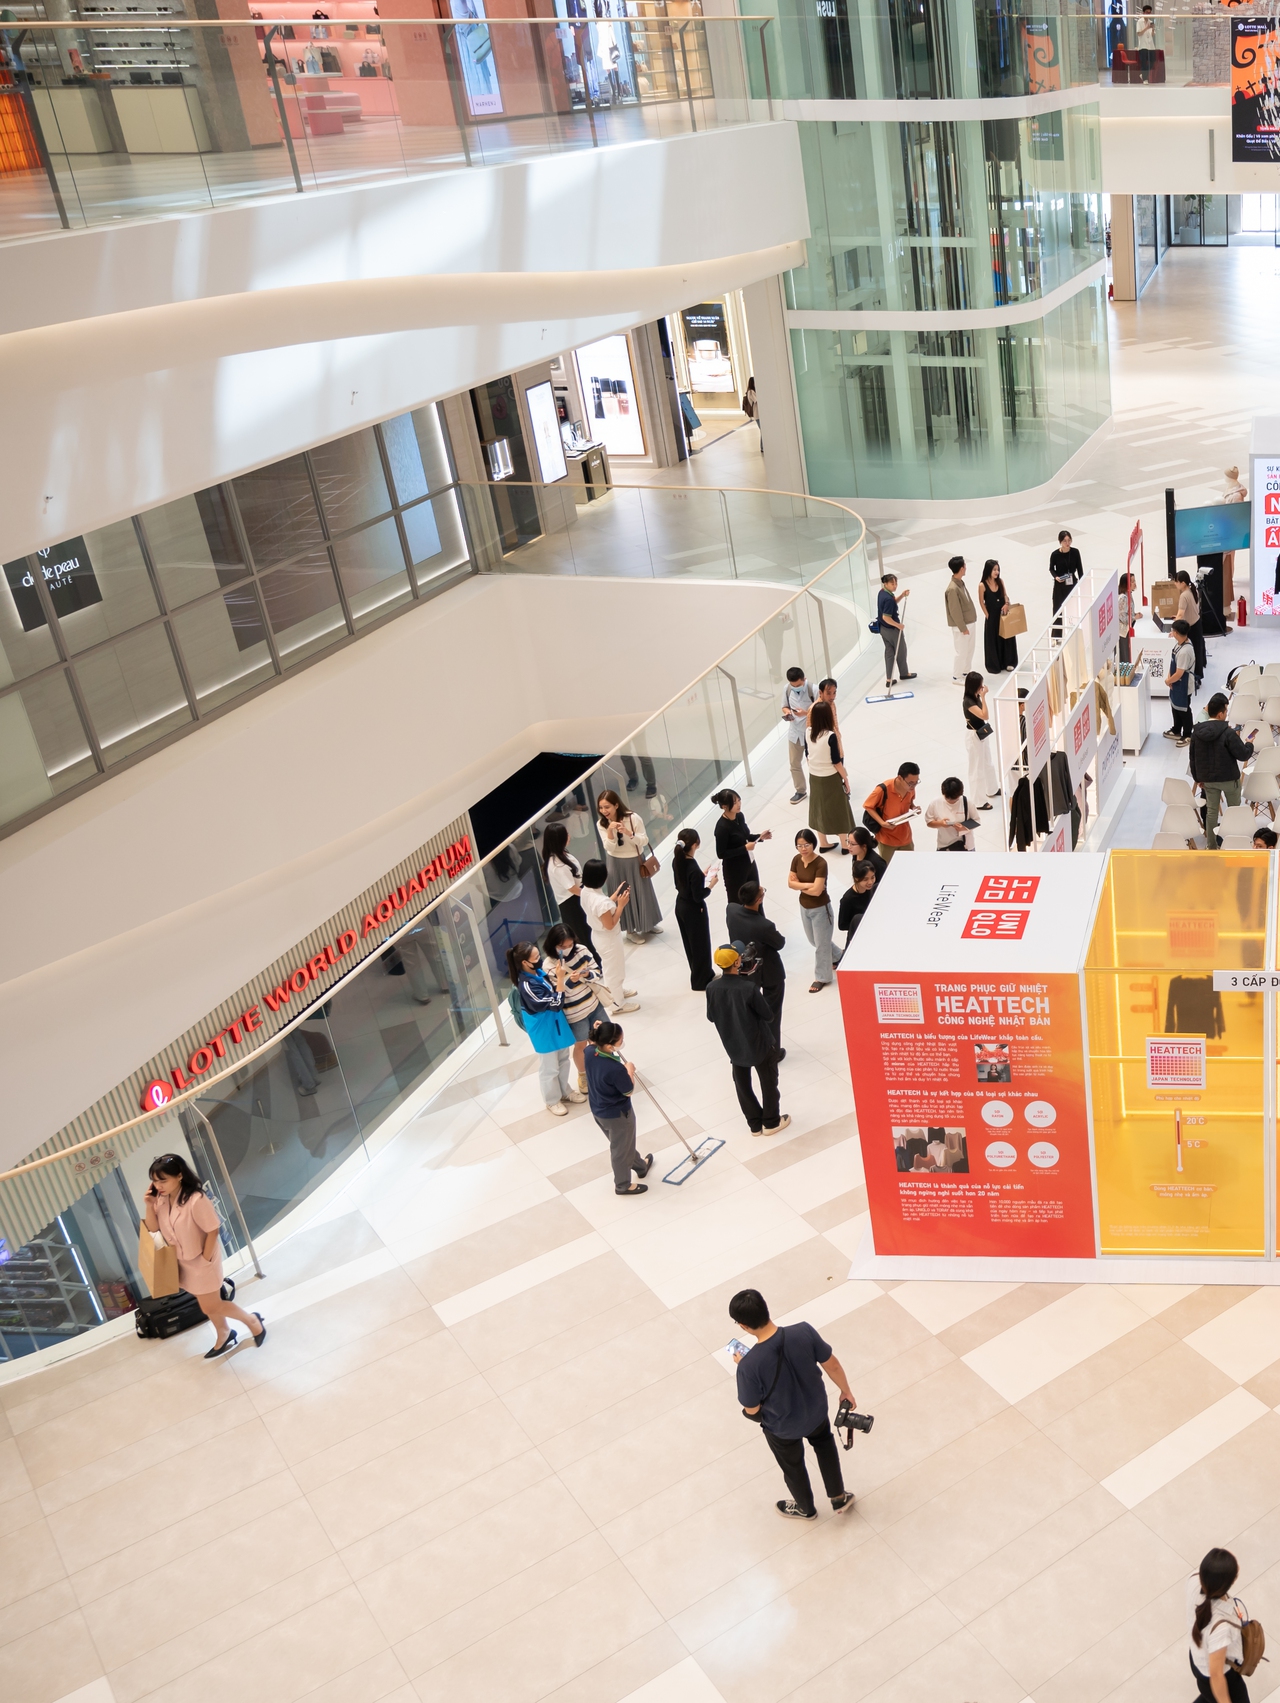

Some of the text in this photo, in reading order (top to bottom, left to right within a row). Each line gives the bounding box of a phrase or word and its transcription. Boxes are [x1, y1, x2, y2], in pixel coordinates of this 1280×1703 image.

[1266, 516, 1279, 525] BẬT
[54, 558, 80, 579] peau
[50, 575, 73, 591] AUTÉ
[448, 854, 474, 879] HANOI
[926, 884, 959, 928] LifeWear
[970, 912, 997, 936] QLO
[995, 912, 1023, 935] UNI
[170, 834, 472, 1090] LOTTE WORLD AQUARIUM
[1231, 977, 1238, 987] 3
[1242, 974, 1266, 987] CẤP
[935, 983, 1048, 995] TRANG PHỤC GIỮ NHIỆT
[936, 996, 1050, 1014] HEATTECH
[938, 1014, 1051, 1027] CÔNG NGHỆ NHẬT BẢN
[1150, 1047, 1202, 1055] HEATTECH
[1187, 1117, 1205, 1125] 20°C
[1187, 1140, 1200, 1148] 5°C
